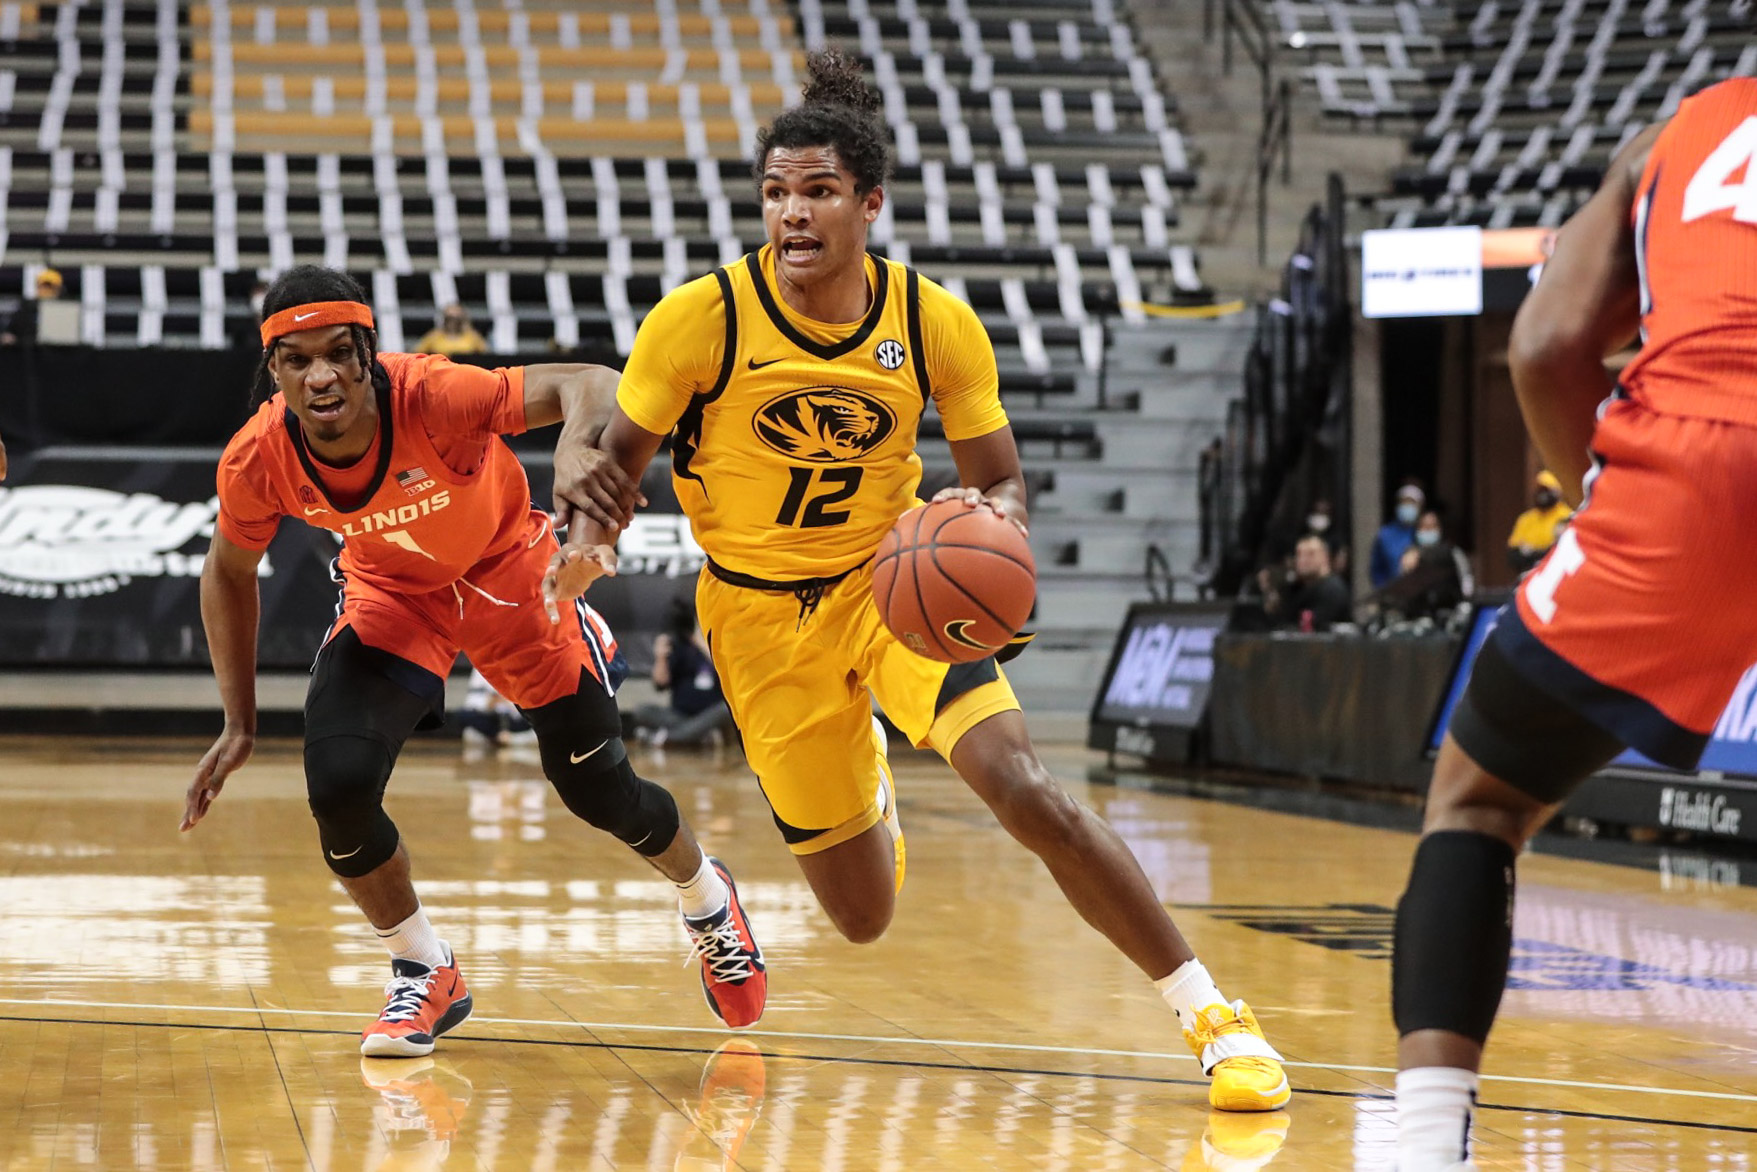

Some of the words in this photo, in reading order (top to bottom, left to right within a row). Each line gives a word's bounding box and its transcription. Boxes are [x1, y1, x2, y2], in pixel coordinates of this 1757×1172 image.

[878, 341, 904, 369] SEC
[342, 489, 450, 537] LINOIS
[775, 466, 864, 529] 12
